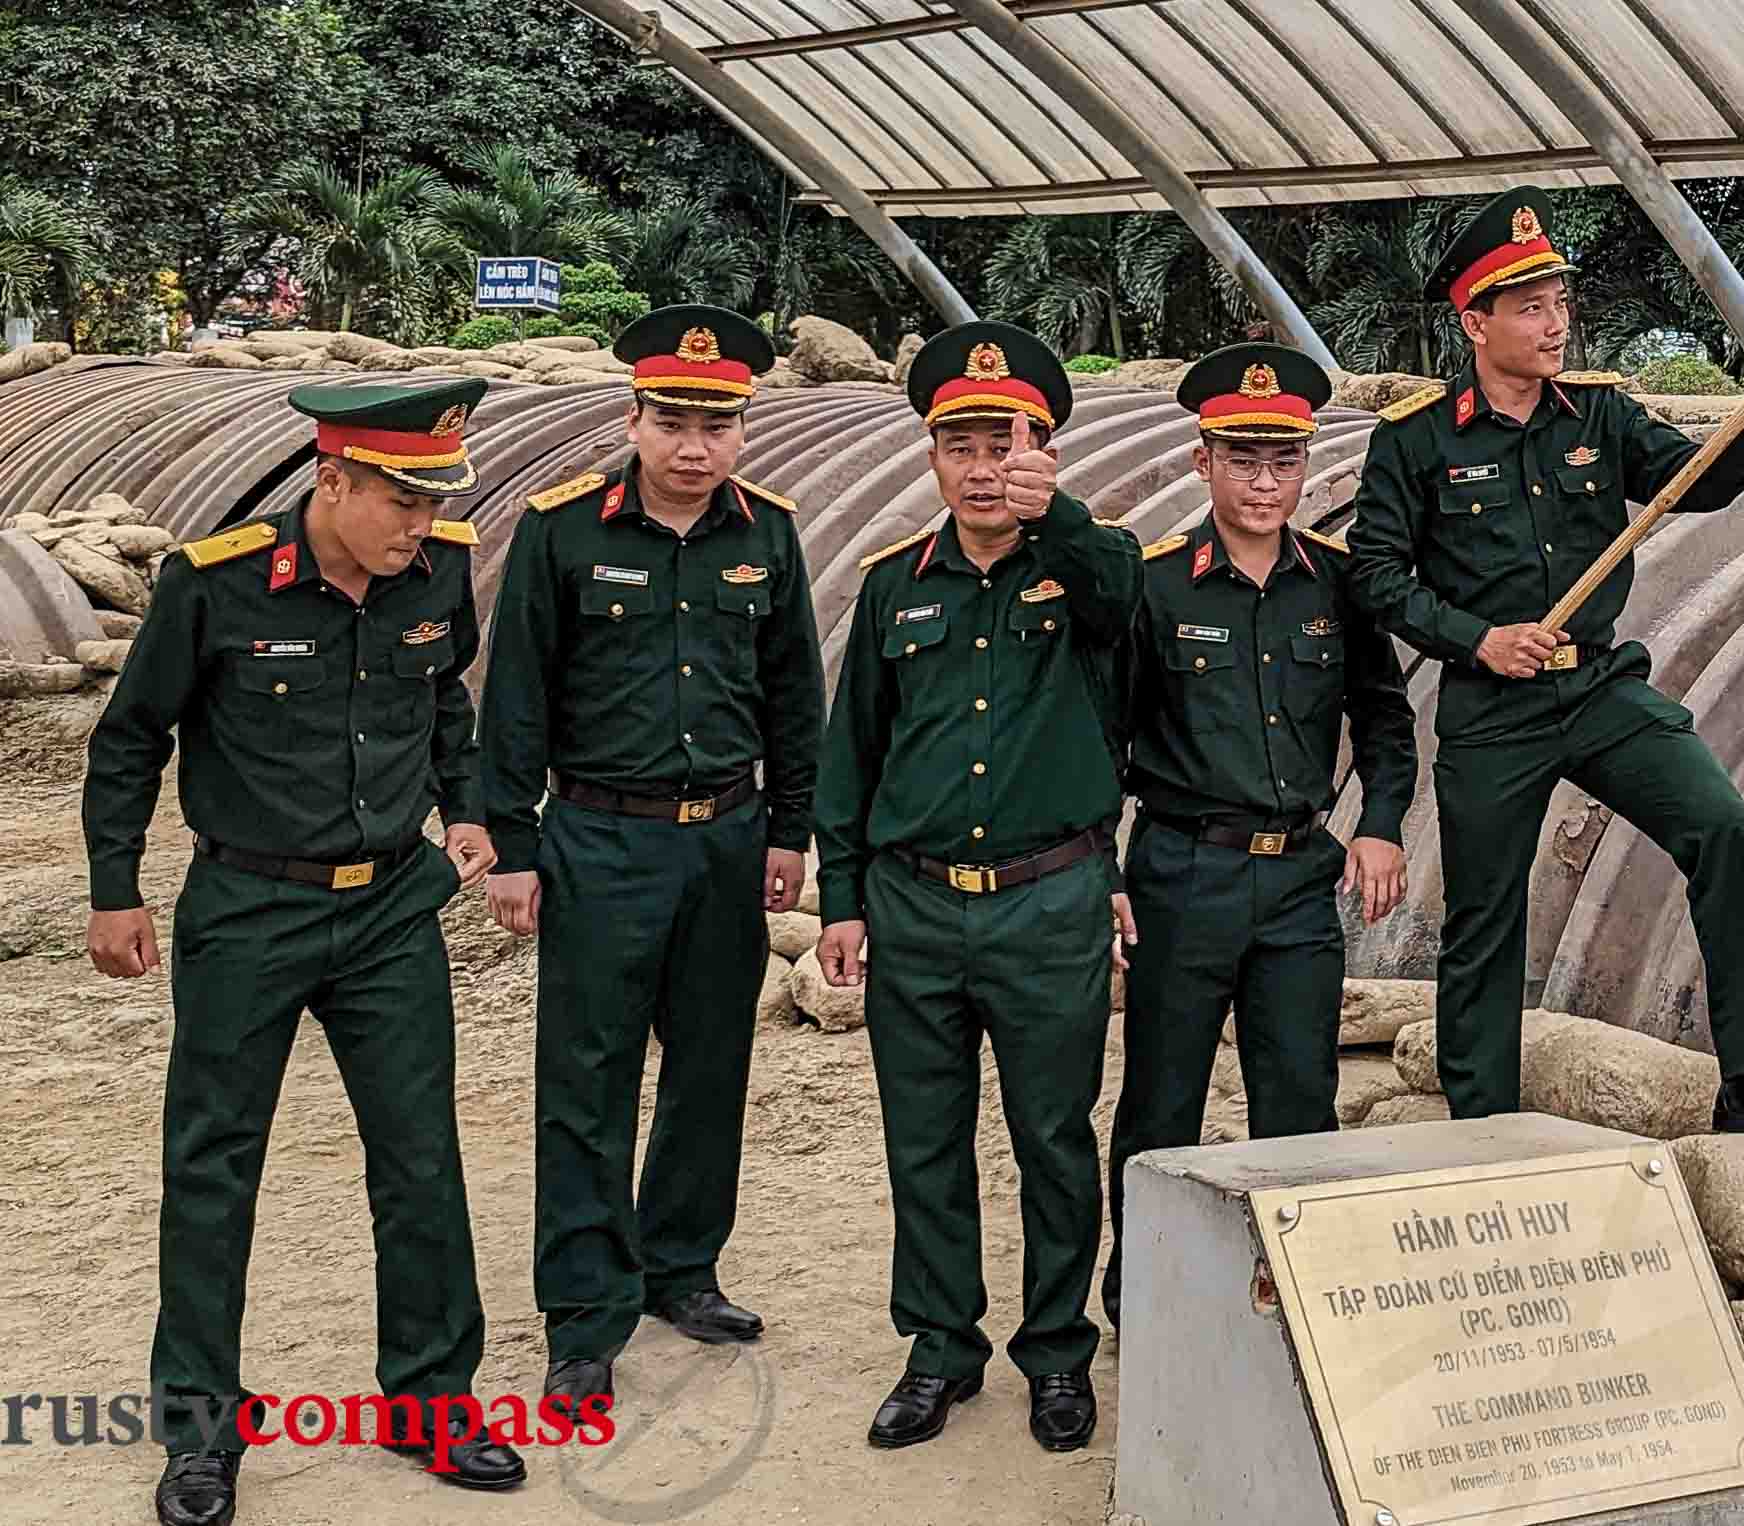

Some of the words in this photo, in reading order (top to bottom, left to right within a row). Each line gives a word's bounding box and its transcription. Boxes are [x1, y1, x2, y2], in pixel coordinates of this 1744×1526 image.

[1392, 1208, 1458, 1254] HẦM
[1465, 1200, 1513, 1245] CHỈ
[1518, 1201, 1571, 1239] HUY
[1322, 1285, 1367, 1320] TẬP
[1373, 1272, 1434, 1310] ĐOÀN
[1581, 1250, 1628, 1282] BIÊN
[1459, 1307, 1503, 1338] (PC.
[1506, 1296, 1571, 1328] GONO)
[1433, 1341, 1526, 1373] 20/11/1953
[1536, 1328, 1616, 1358] 07/5/1954
[1432, 1401, 1473, 1429] THE
[1474, 1384, 1573, 1421] COMMAND
[1576, 1372, 1652, 1405] BUNKER
[1373, 1455, 1392, 1476] OF
[1396, 1449, 1425, 1473] THE
[1428, 1443, 1463, 1467] DIEN
[1465, 1438, 1499, 1461] BIEN
[1501, 1433, 1531, 1455] PHU
[1533, 1422, 1604, 1450] FORTRESS
[1605, 1412, 1651, 1437] GROUP
[1543, 1456, 1577, 1476] 1953
[1595, 1447, 1624, 1470] May
